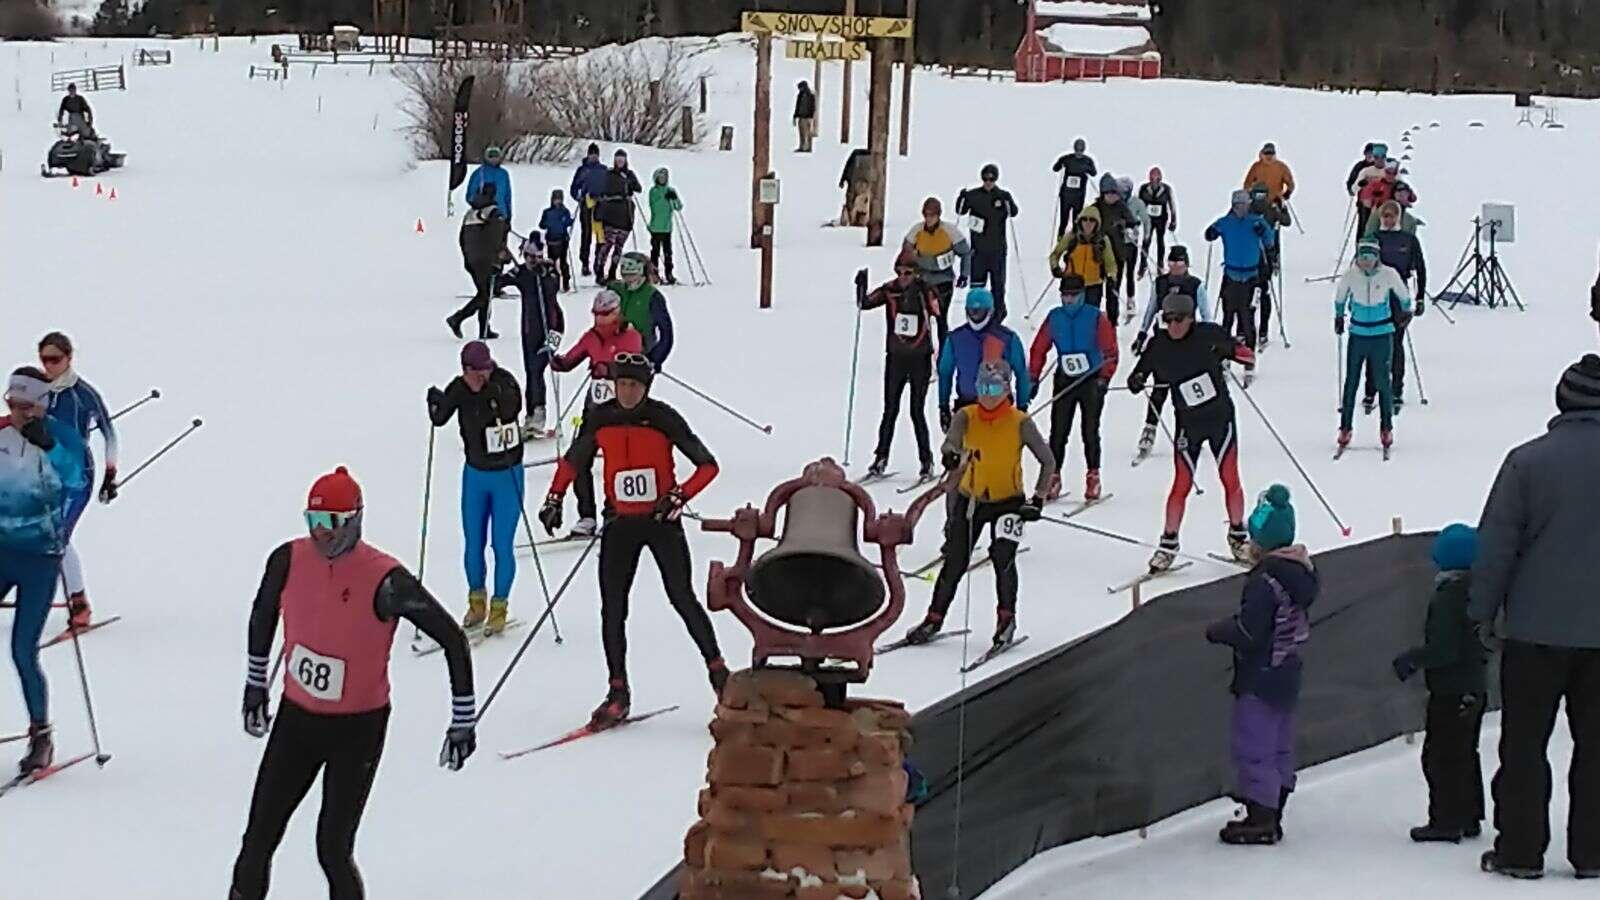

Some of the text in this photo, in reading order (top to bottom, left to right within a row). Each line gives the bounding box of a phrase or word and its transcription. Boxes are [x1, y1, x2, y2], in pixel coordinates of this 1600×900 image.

[775, 13, 874, 35] SNOWSHOE
[794, 41, 861, 60] TRAILS
[901, 317, 909, 332] 3
[1066, 357, 1083, 372] 61
[594, 384, 609, 400] 67
[1192, 382, 1205, 399] 9
[494, 427, 514, 447] 70
[623, 474, 647, 497] 80
[1004, 515, 1024, 537] 93
[298, 656, 331, 692] 68
